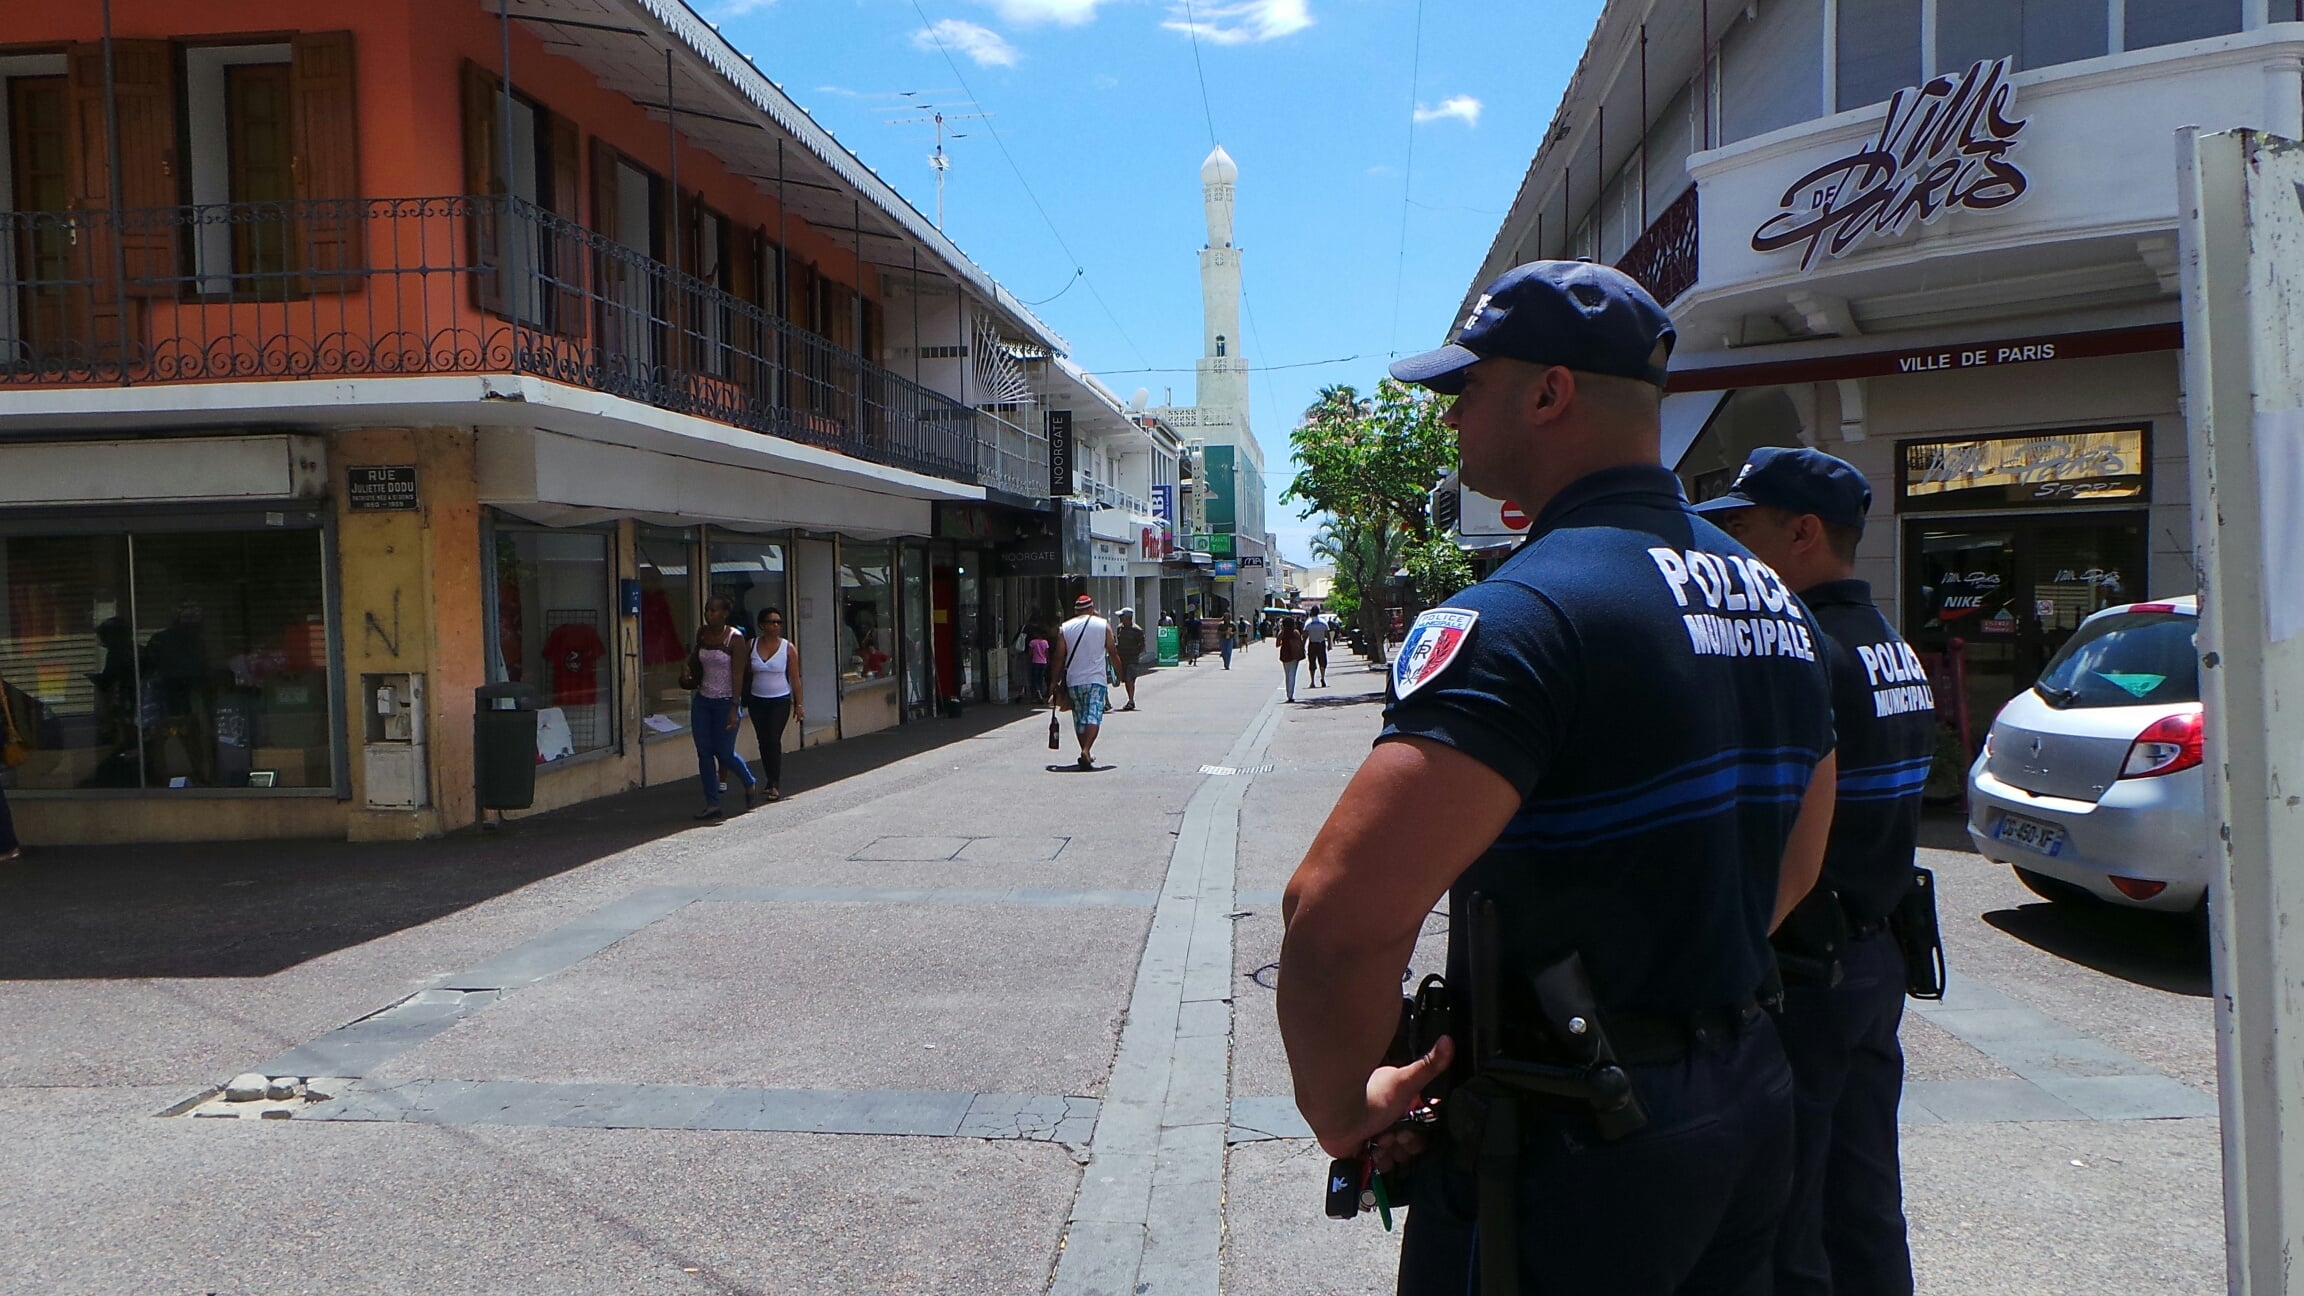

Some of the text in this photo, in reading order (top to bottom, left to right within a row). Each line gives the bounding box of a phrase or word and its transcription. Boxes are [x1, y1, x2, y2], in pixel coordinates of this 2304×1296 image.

[1859, 60, 2027, 189] Ville
[1812, 185, 1836, 210] DE
[1900, 344, 2055, 372] VILLE DE PARIS
[1053, 416, 1064, 485] NOORGATE
[351, 481, 414, 494] JULIETTE DODU
[368, 470, 396, 481] RUE
[1001, 551, 1056, 562] NOORGATE
[1648, 548, 1803, 619] POLICE
[1944, 596, 1984, 608] NIKE
[1422, 614, 1465, 623] POLICE
[1682, 614, 1816, 662] MUNICIPALE
